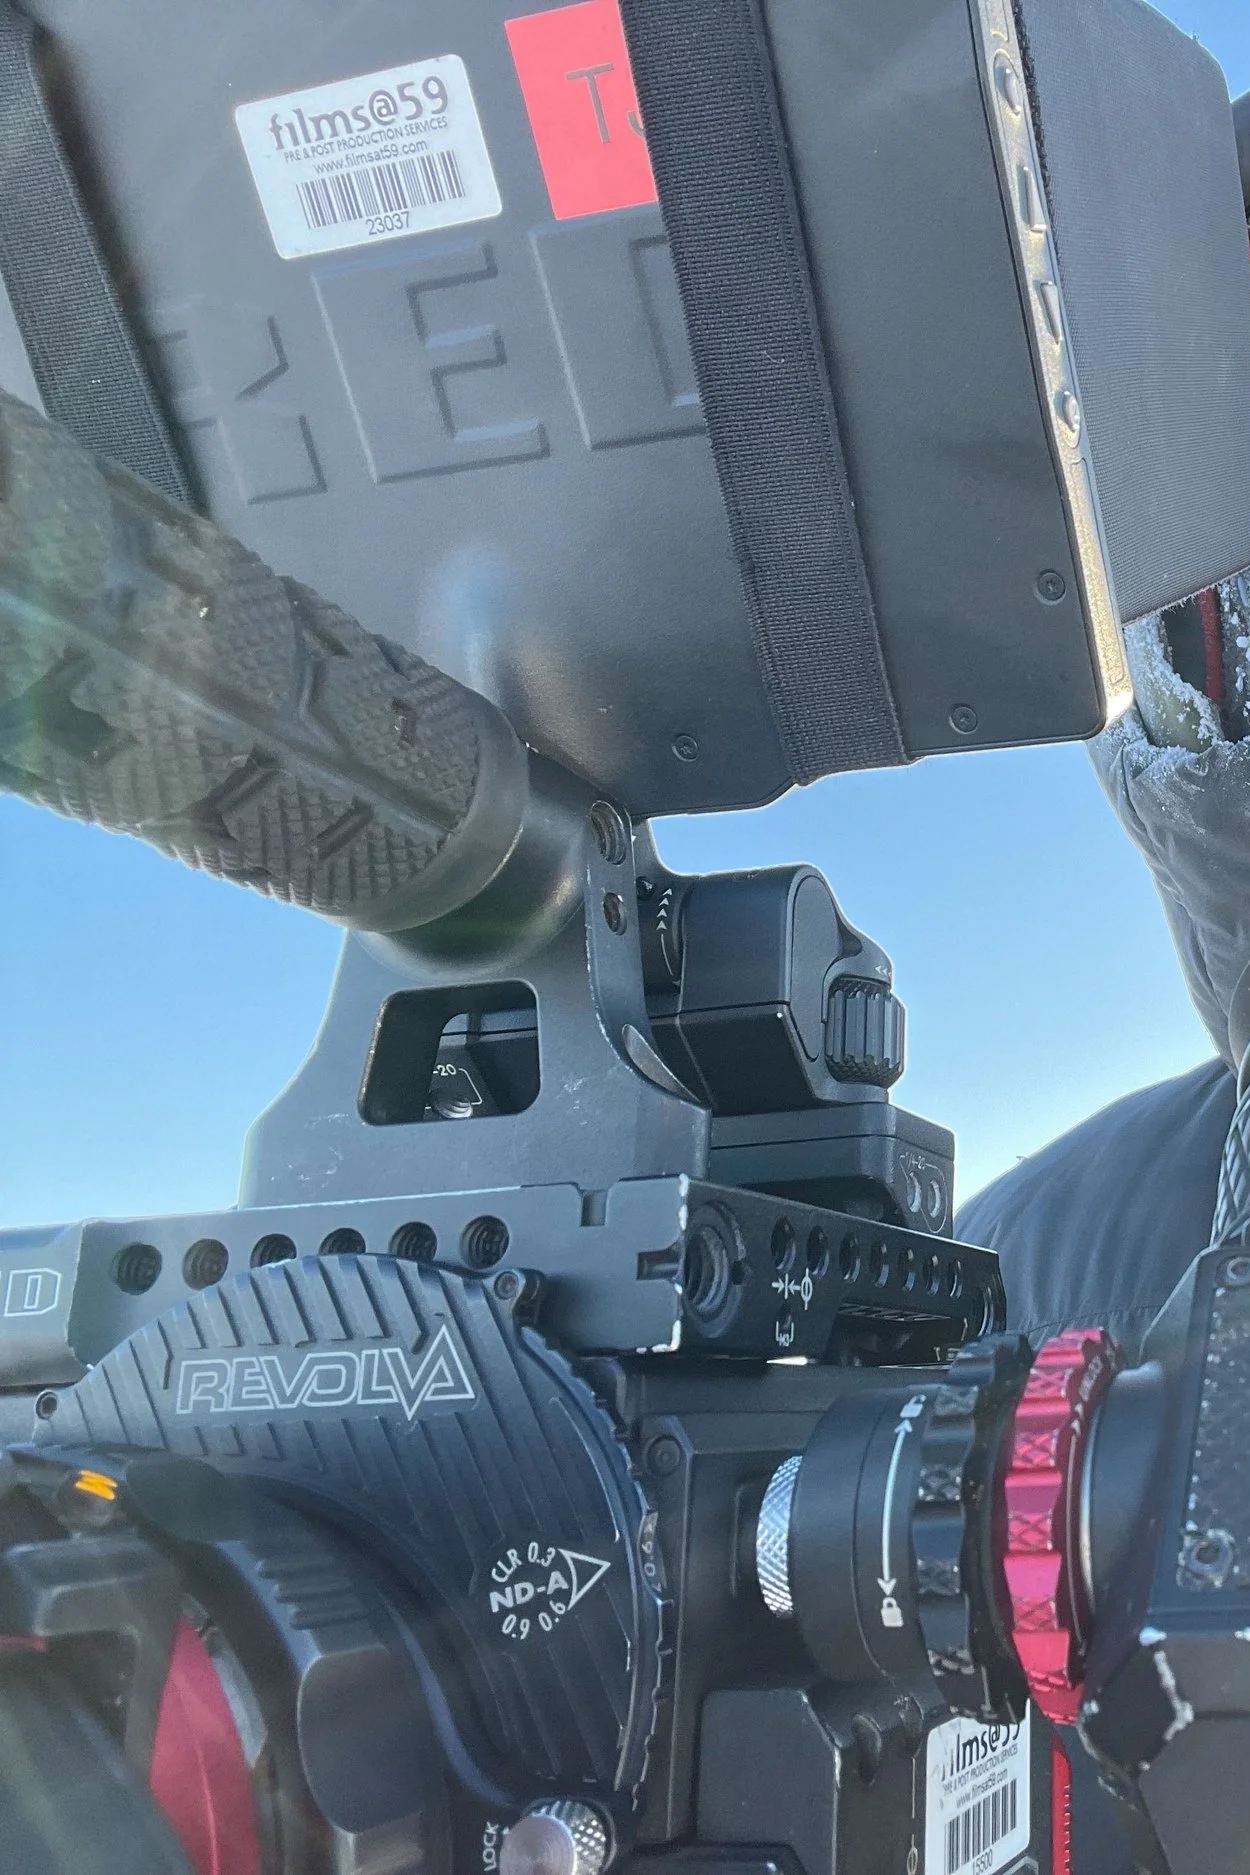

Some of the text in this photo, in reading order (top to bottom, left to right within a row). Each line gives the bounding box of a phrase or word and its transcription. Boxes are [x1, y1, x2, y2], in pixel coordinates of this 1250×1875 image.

[269, 76, 449, 150] films@59
[566, 63, 646, 145] T
[284, 149, 301, 164] PRE
[311, 141, 335, 157] POST
[337, 126, 403, 151] PRODUCTION
[405, 116, 448, 136] SERVICES
[366, 211, 410, 236] 23037
[176, 1323, 475, 1420] REVOLVA
[491, 1541, 556, 1583] CLR 0.3
[489, 1571, 570, 1613] ND-A
[502, 1600, 566, 1640] 0.9 0.6
[482, 1821, 500, 1872] LOCK
